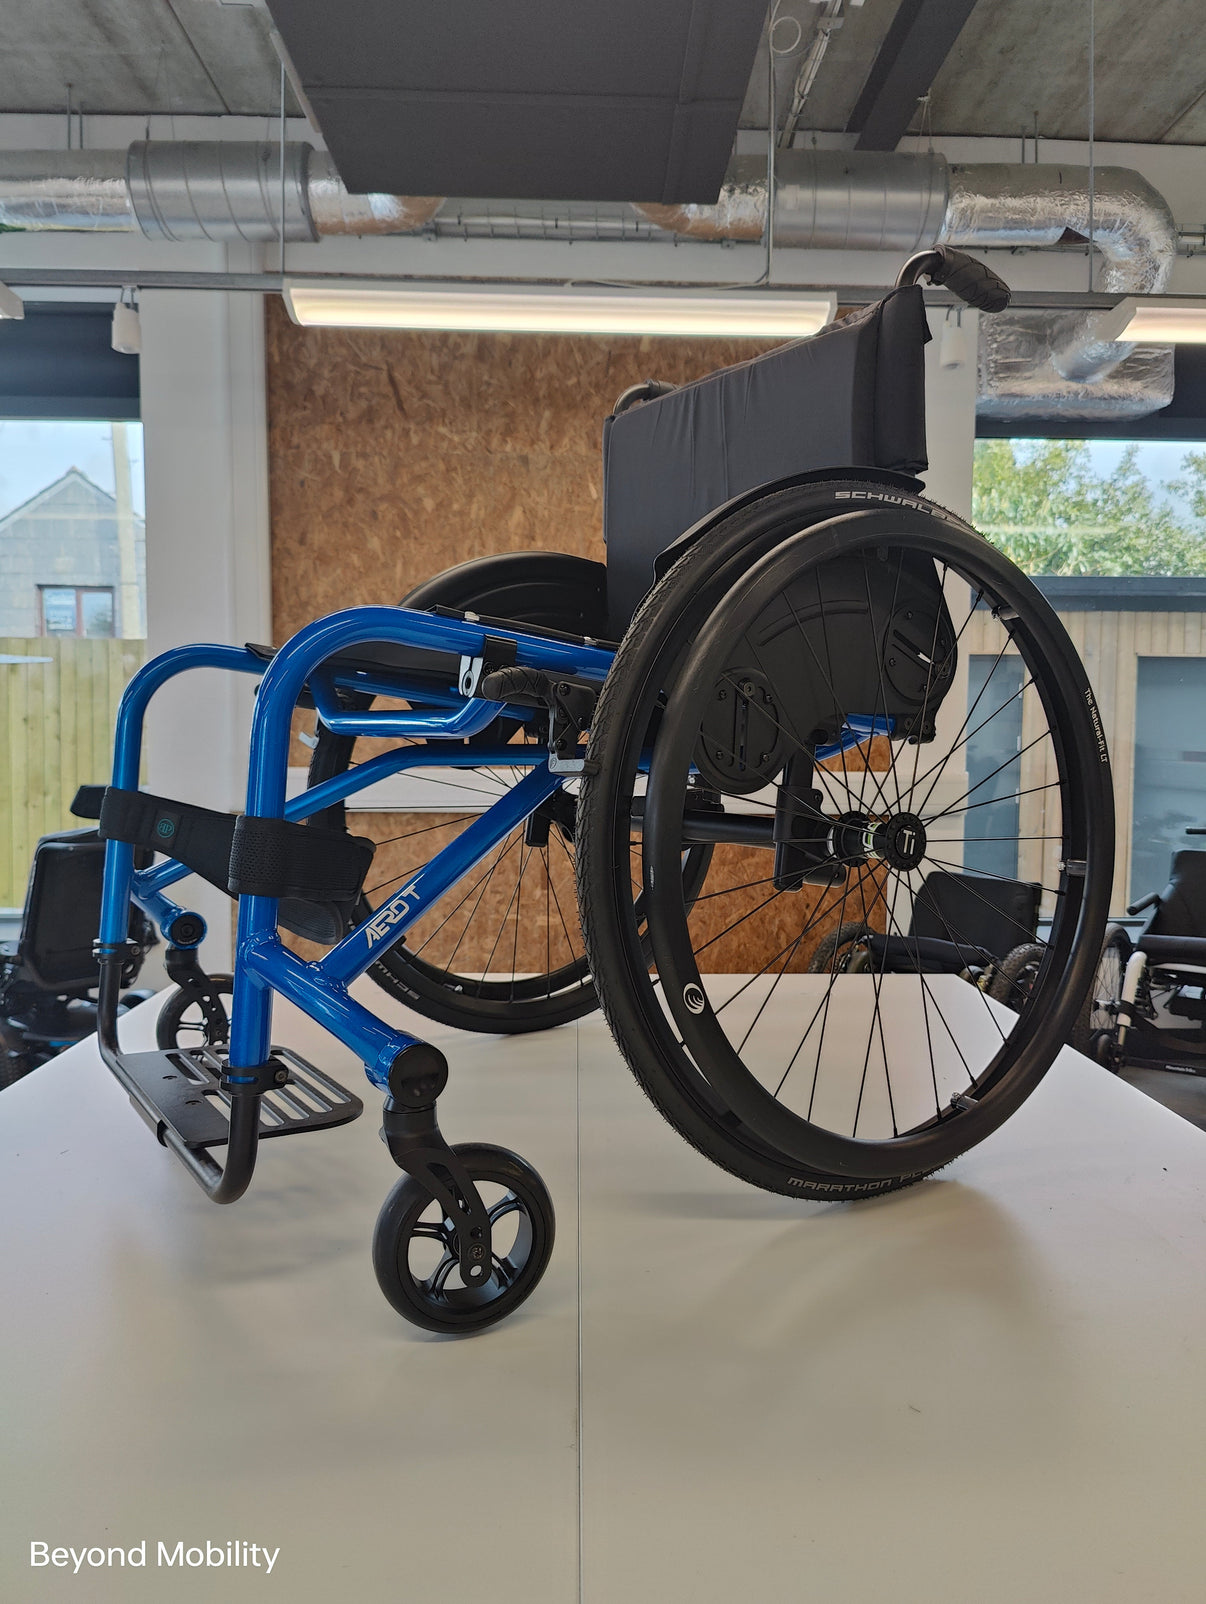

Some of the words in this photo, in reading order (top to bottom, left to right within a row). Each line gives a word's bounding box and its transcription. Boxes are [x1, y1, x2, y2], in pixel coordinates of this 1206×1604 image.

[1084, 687, 1094, 706] The
[1089, 705, 1106, 753] Natural-Fit
[1100, 753, 1108, 763] LT
[903, 829, 916, 855] Ti
[365, 899, 410, 949] AERO
[401, 885, 421, 900] T
[787, 1176, 892, 1192] MARATHON
